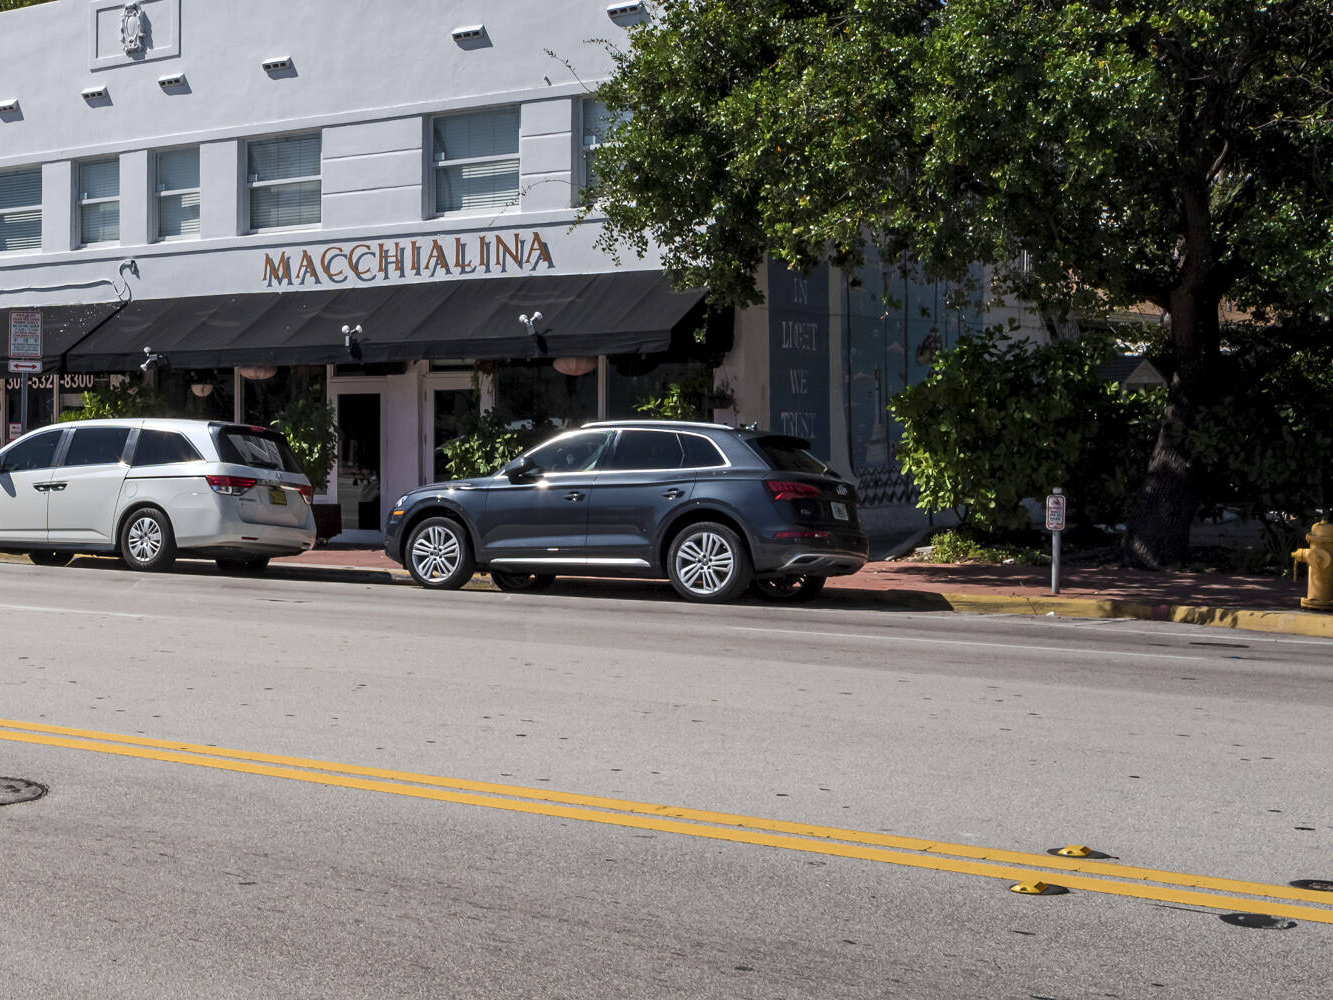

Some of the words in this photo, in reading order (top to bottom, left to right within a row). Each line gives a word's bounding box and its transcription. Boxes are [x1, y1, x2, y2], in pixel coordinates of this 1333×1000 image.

[262, 231, 550, 282] MACCHIALINA
[793, 277, 808, 305] IN
[781, 321, 818, 351] LIGHT
[6, 374, 94, 390] 30-532-8300
[789, 369, 809, 395] WE
[781, 411, 817, 439] TRUST
